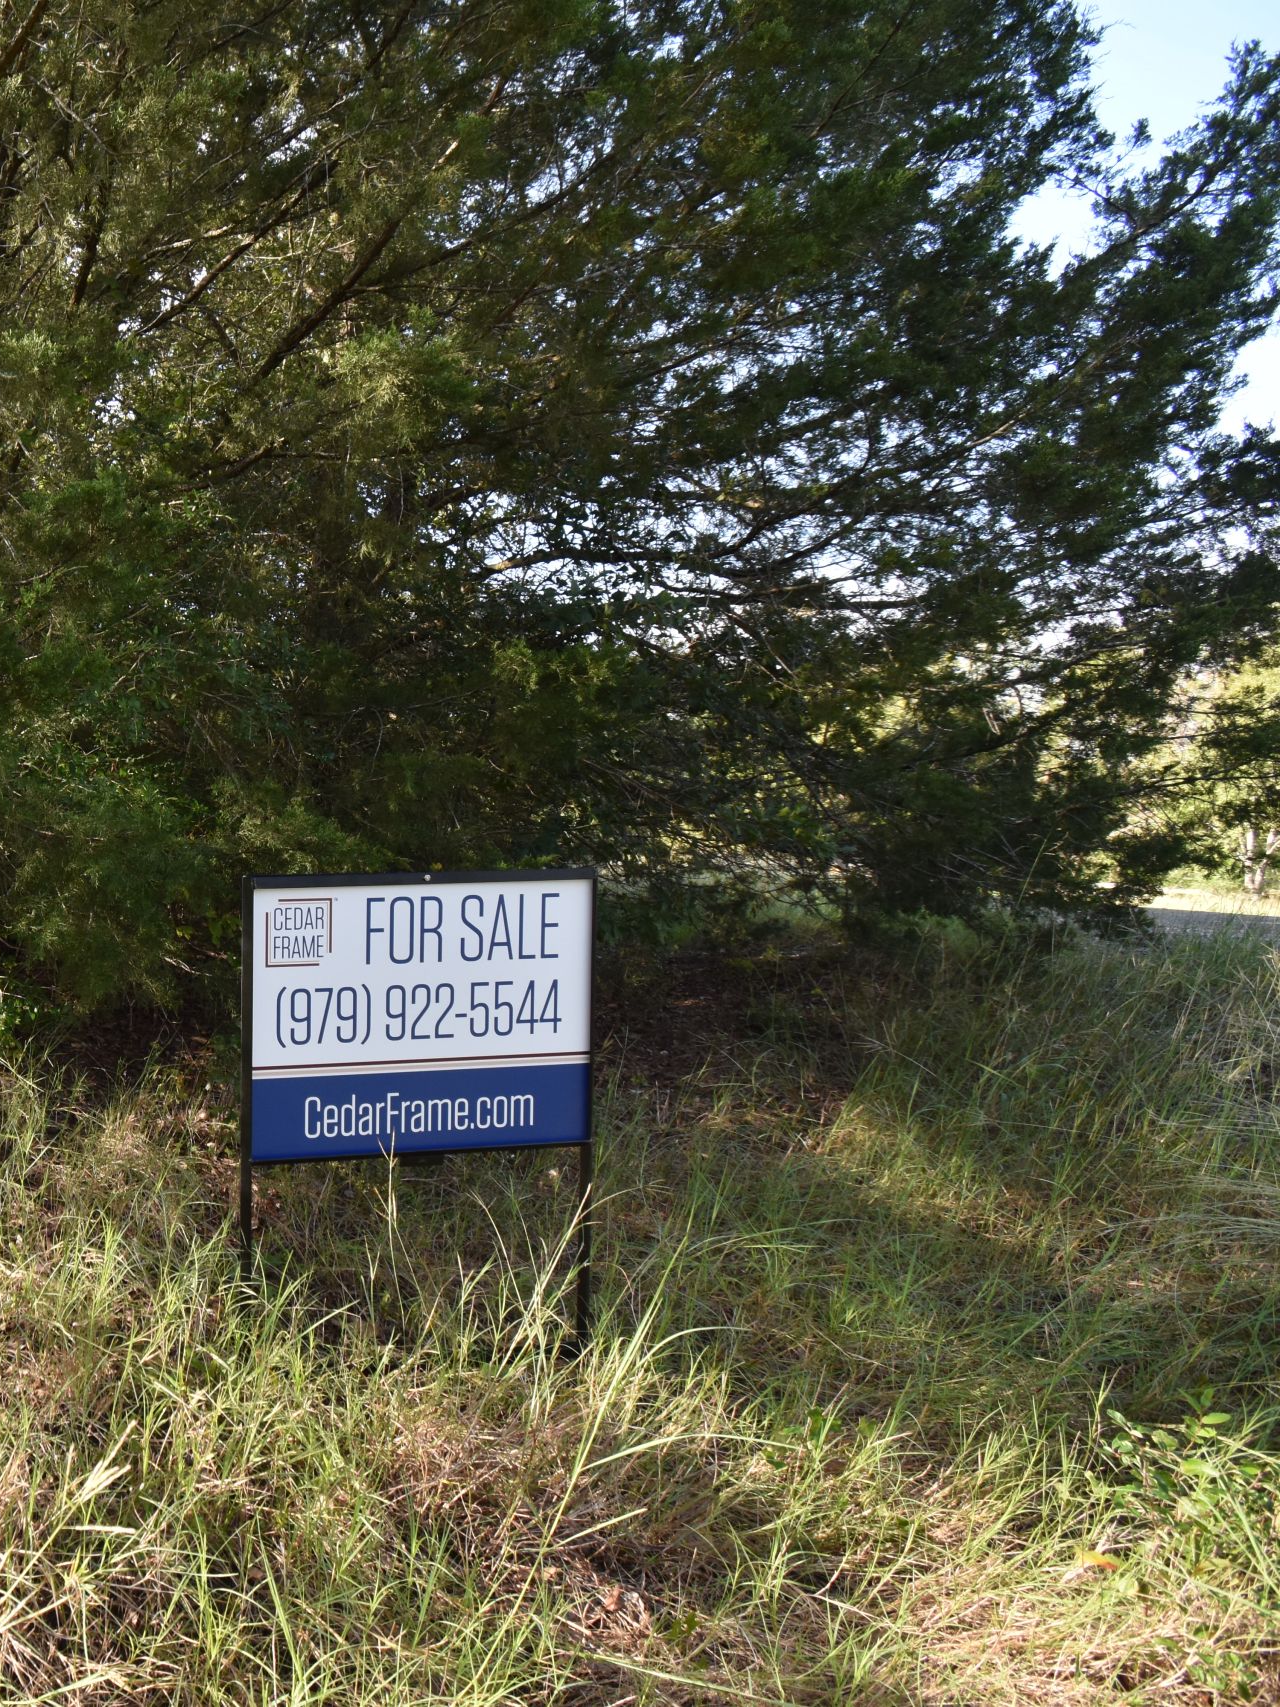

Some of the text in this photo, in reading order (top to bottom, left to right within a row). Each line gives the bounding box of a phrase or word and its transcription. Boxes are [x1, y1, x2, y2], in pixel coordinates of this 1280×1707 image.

[273, 906, 325, 931] CEDAR
[365, 892, 560, 965] FOR SALE
[273, 934, 324, 959] FRAME
[276, 979, 562, 1048] (979) 922-5544
[304, 1092, 534, 1139] CedarFrame.com
